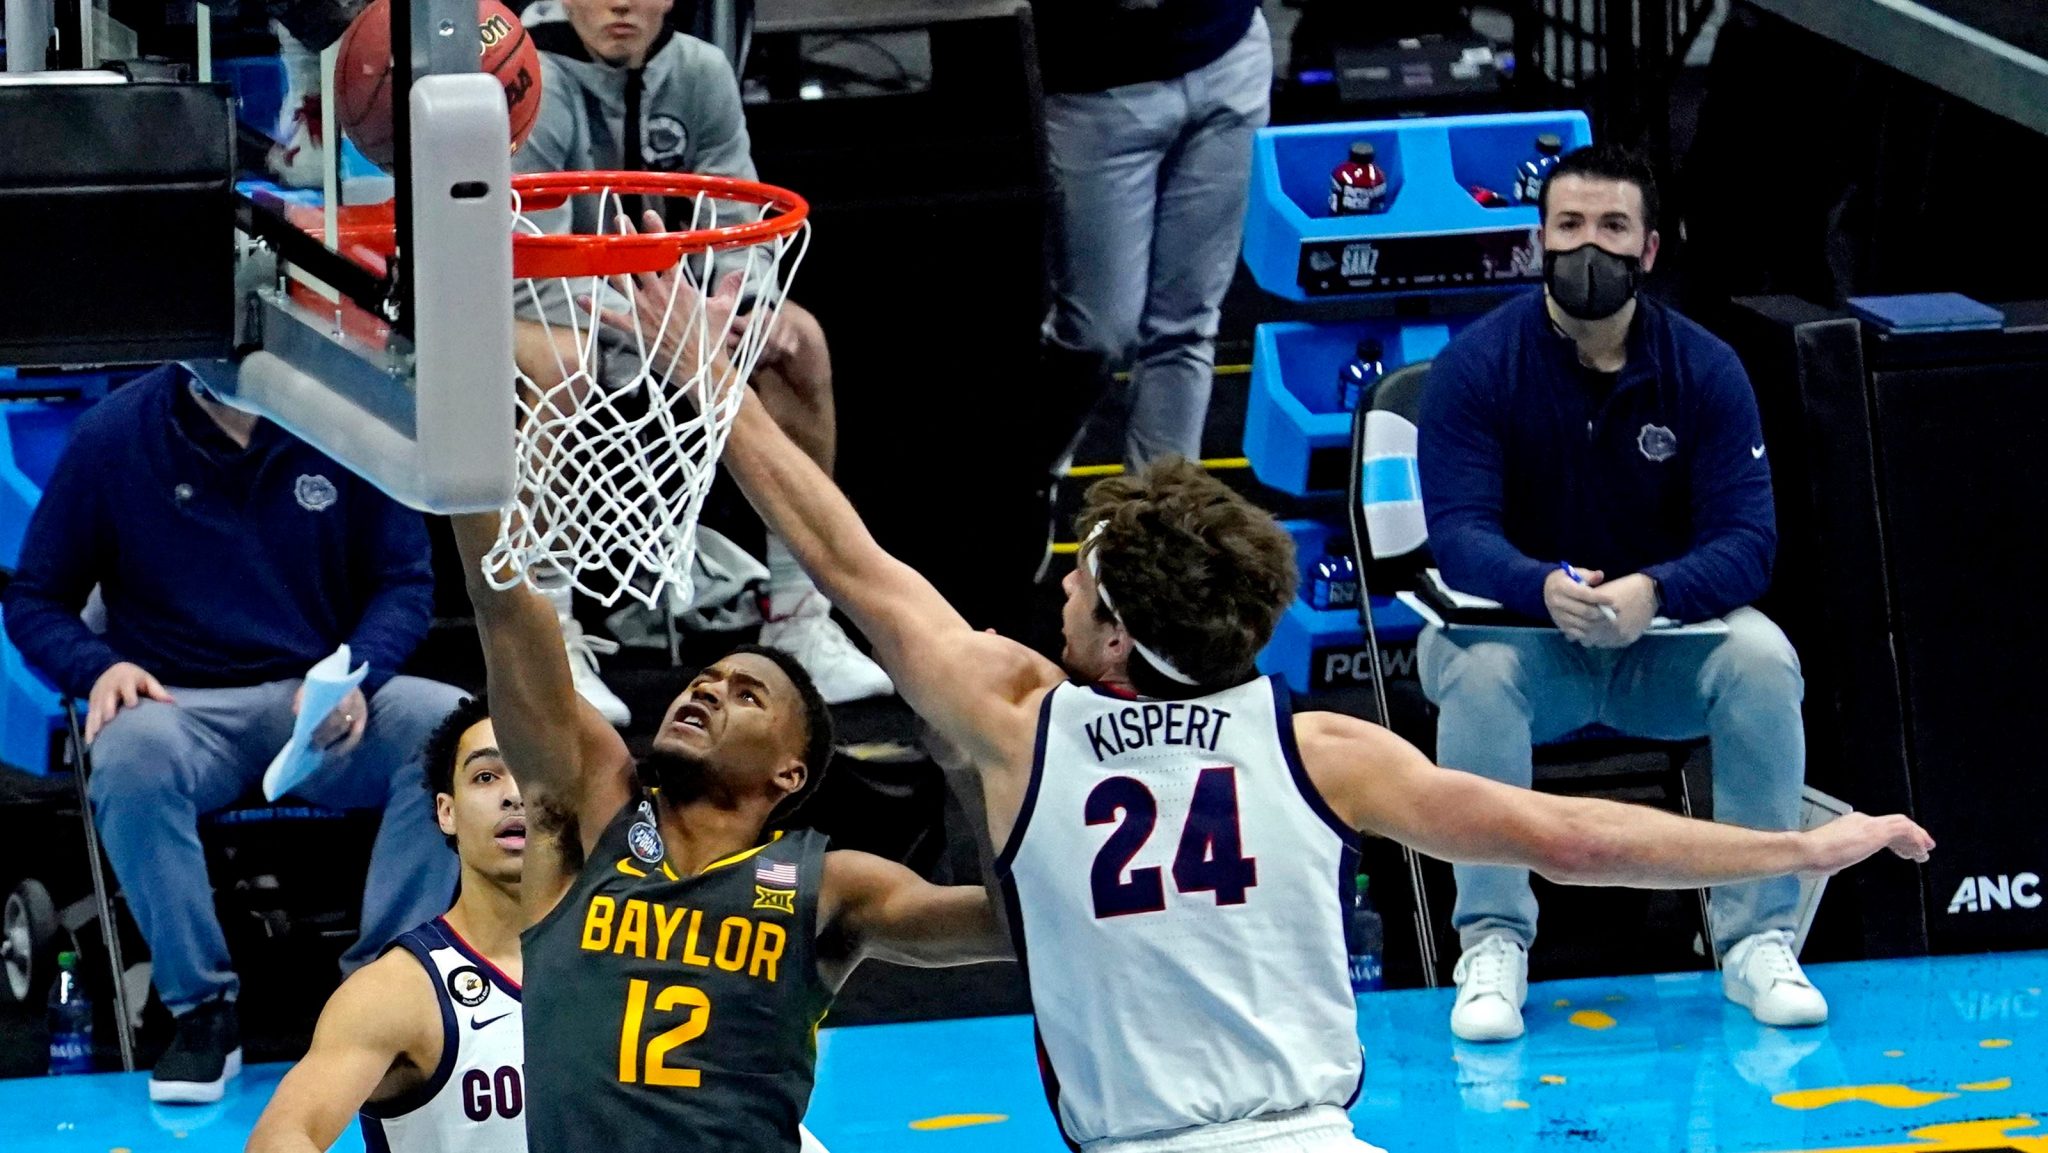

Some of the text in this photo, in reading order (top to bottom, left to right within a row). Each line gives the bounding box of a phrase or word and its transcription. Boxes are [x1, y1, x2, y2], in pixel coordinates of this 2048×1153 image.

[479, 13, 513, 56] on
[1085, 703, 1231, 761] KISPERT
[1085, 766, 1257, 919] 24
[1948, 872, 2042, 914] ANC
[580, 895, 786, 982] BAYLOR
[619, 979, 710, 1088] 12
[462, 1065, 524, 1122] GO
